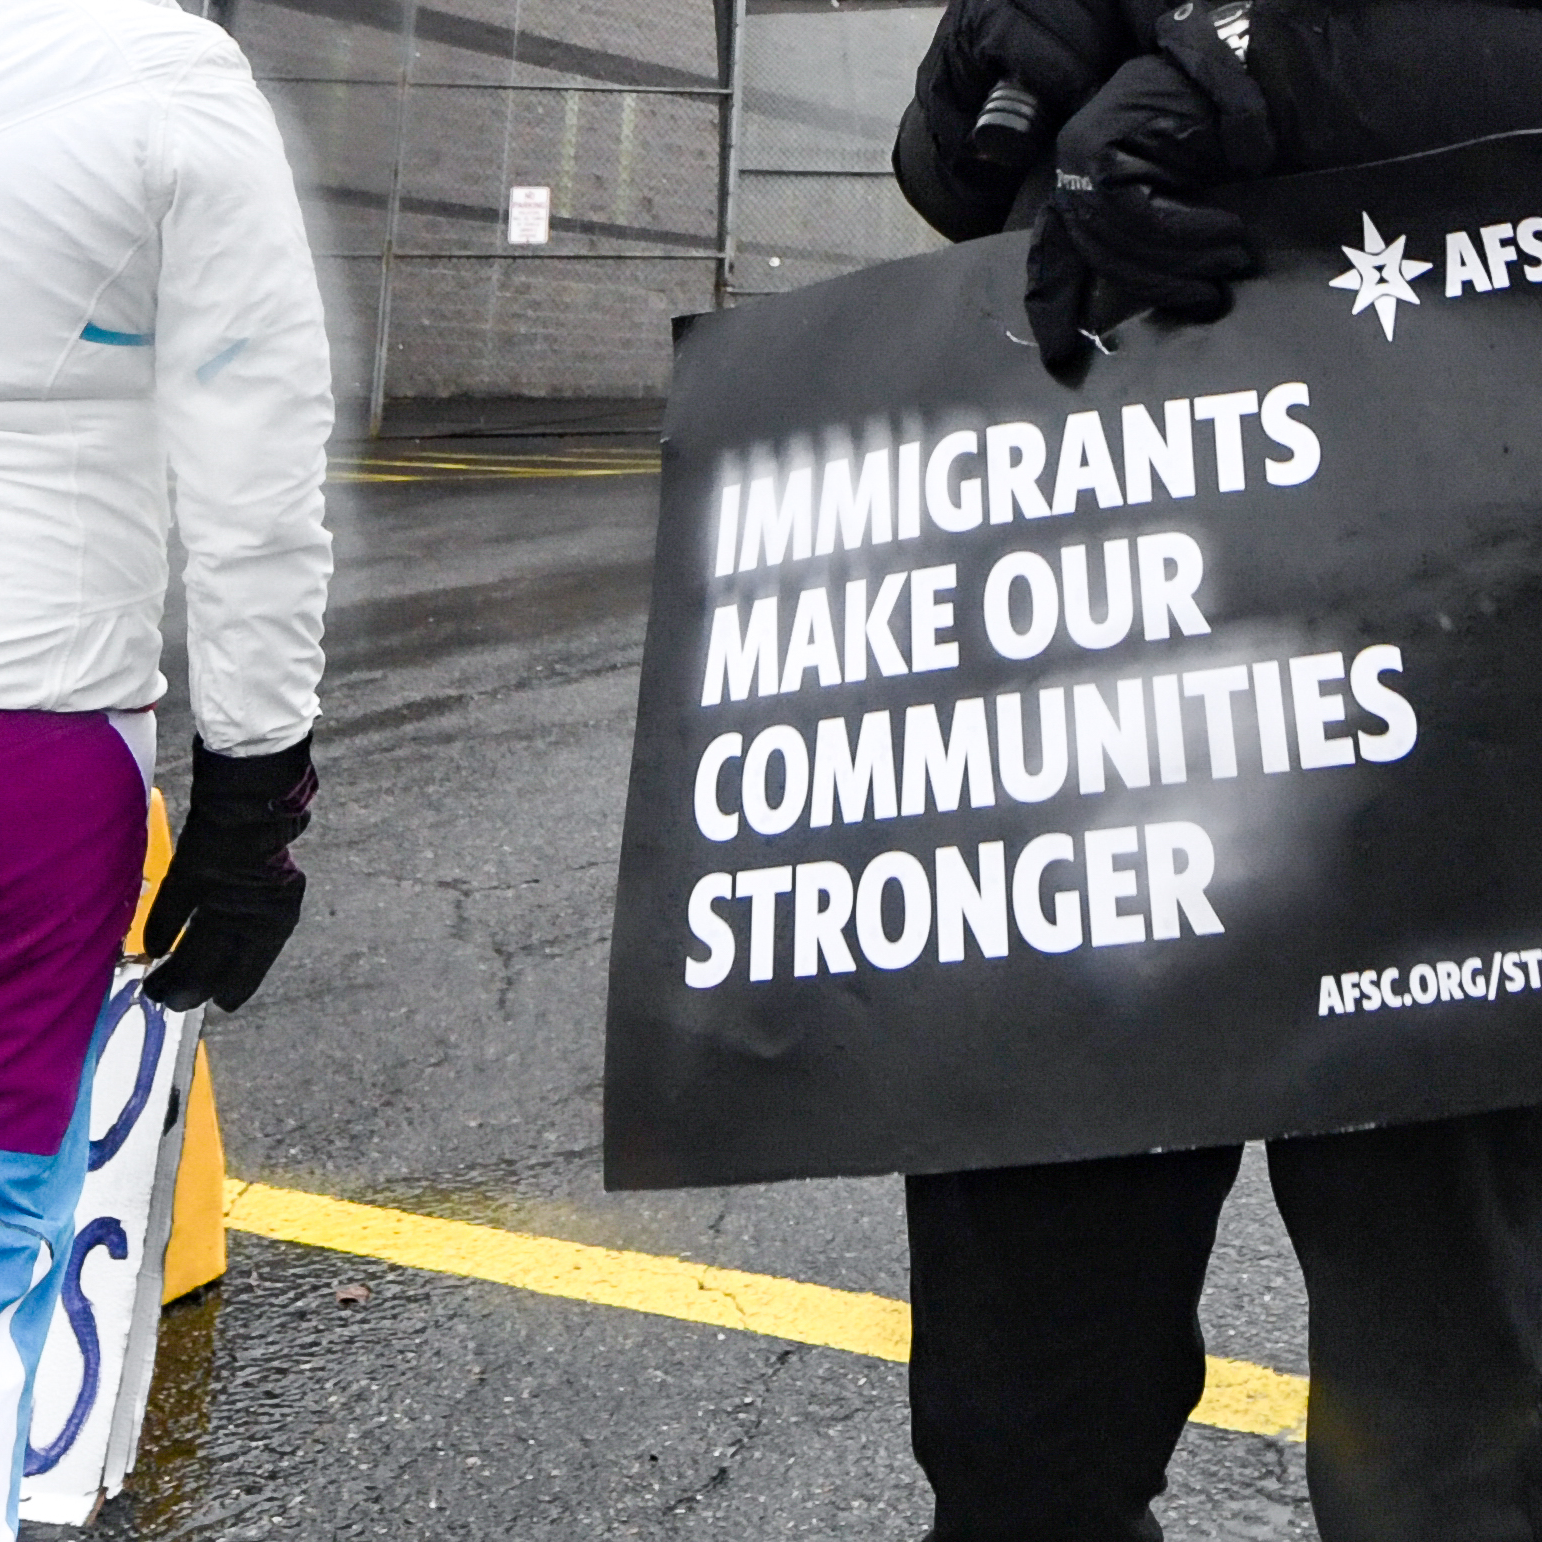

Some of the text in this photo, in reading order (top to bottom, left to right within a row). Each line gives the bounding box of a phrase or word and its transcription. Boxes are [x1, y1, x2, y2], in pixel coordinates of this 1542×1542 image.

[714, 383, 1321, 577] IMMIGRANTS
[700, 532, 1212, 707] MAKE OUR
[693, 644, 1418, 842] COMMUNITIES
[684, 820, 1226, 988] STRONGER
